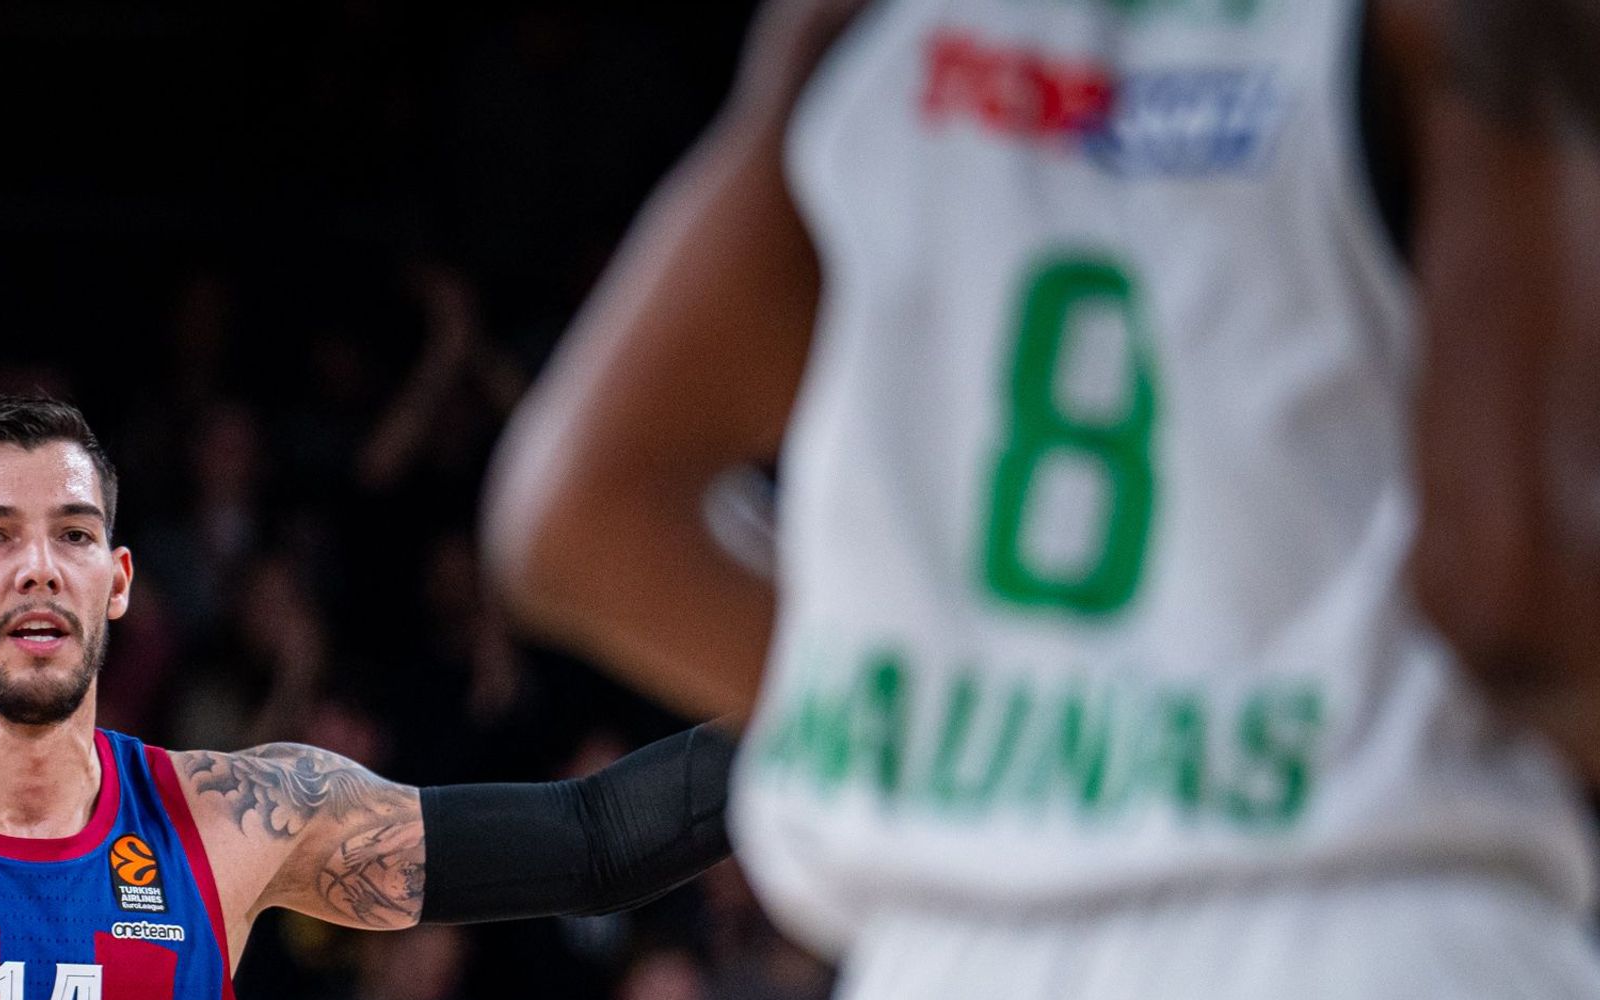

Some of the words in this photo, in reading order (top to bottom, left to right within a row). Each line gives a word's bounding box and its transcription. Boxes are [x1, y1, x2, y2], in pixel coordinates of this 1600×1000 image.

[980, 245, 1157, 622] 8
[118, 885, 162, 896] TURKISH
[120, 894, 163, 904] AIRLINES
[121, 902, 165, 912] EuroLeague
